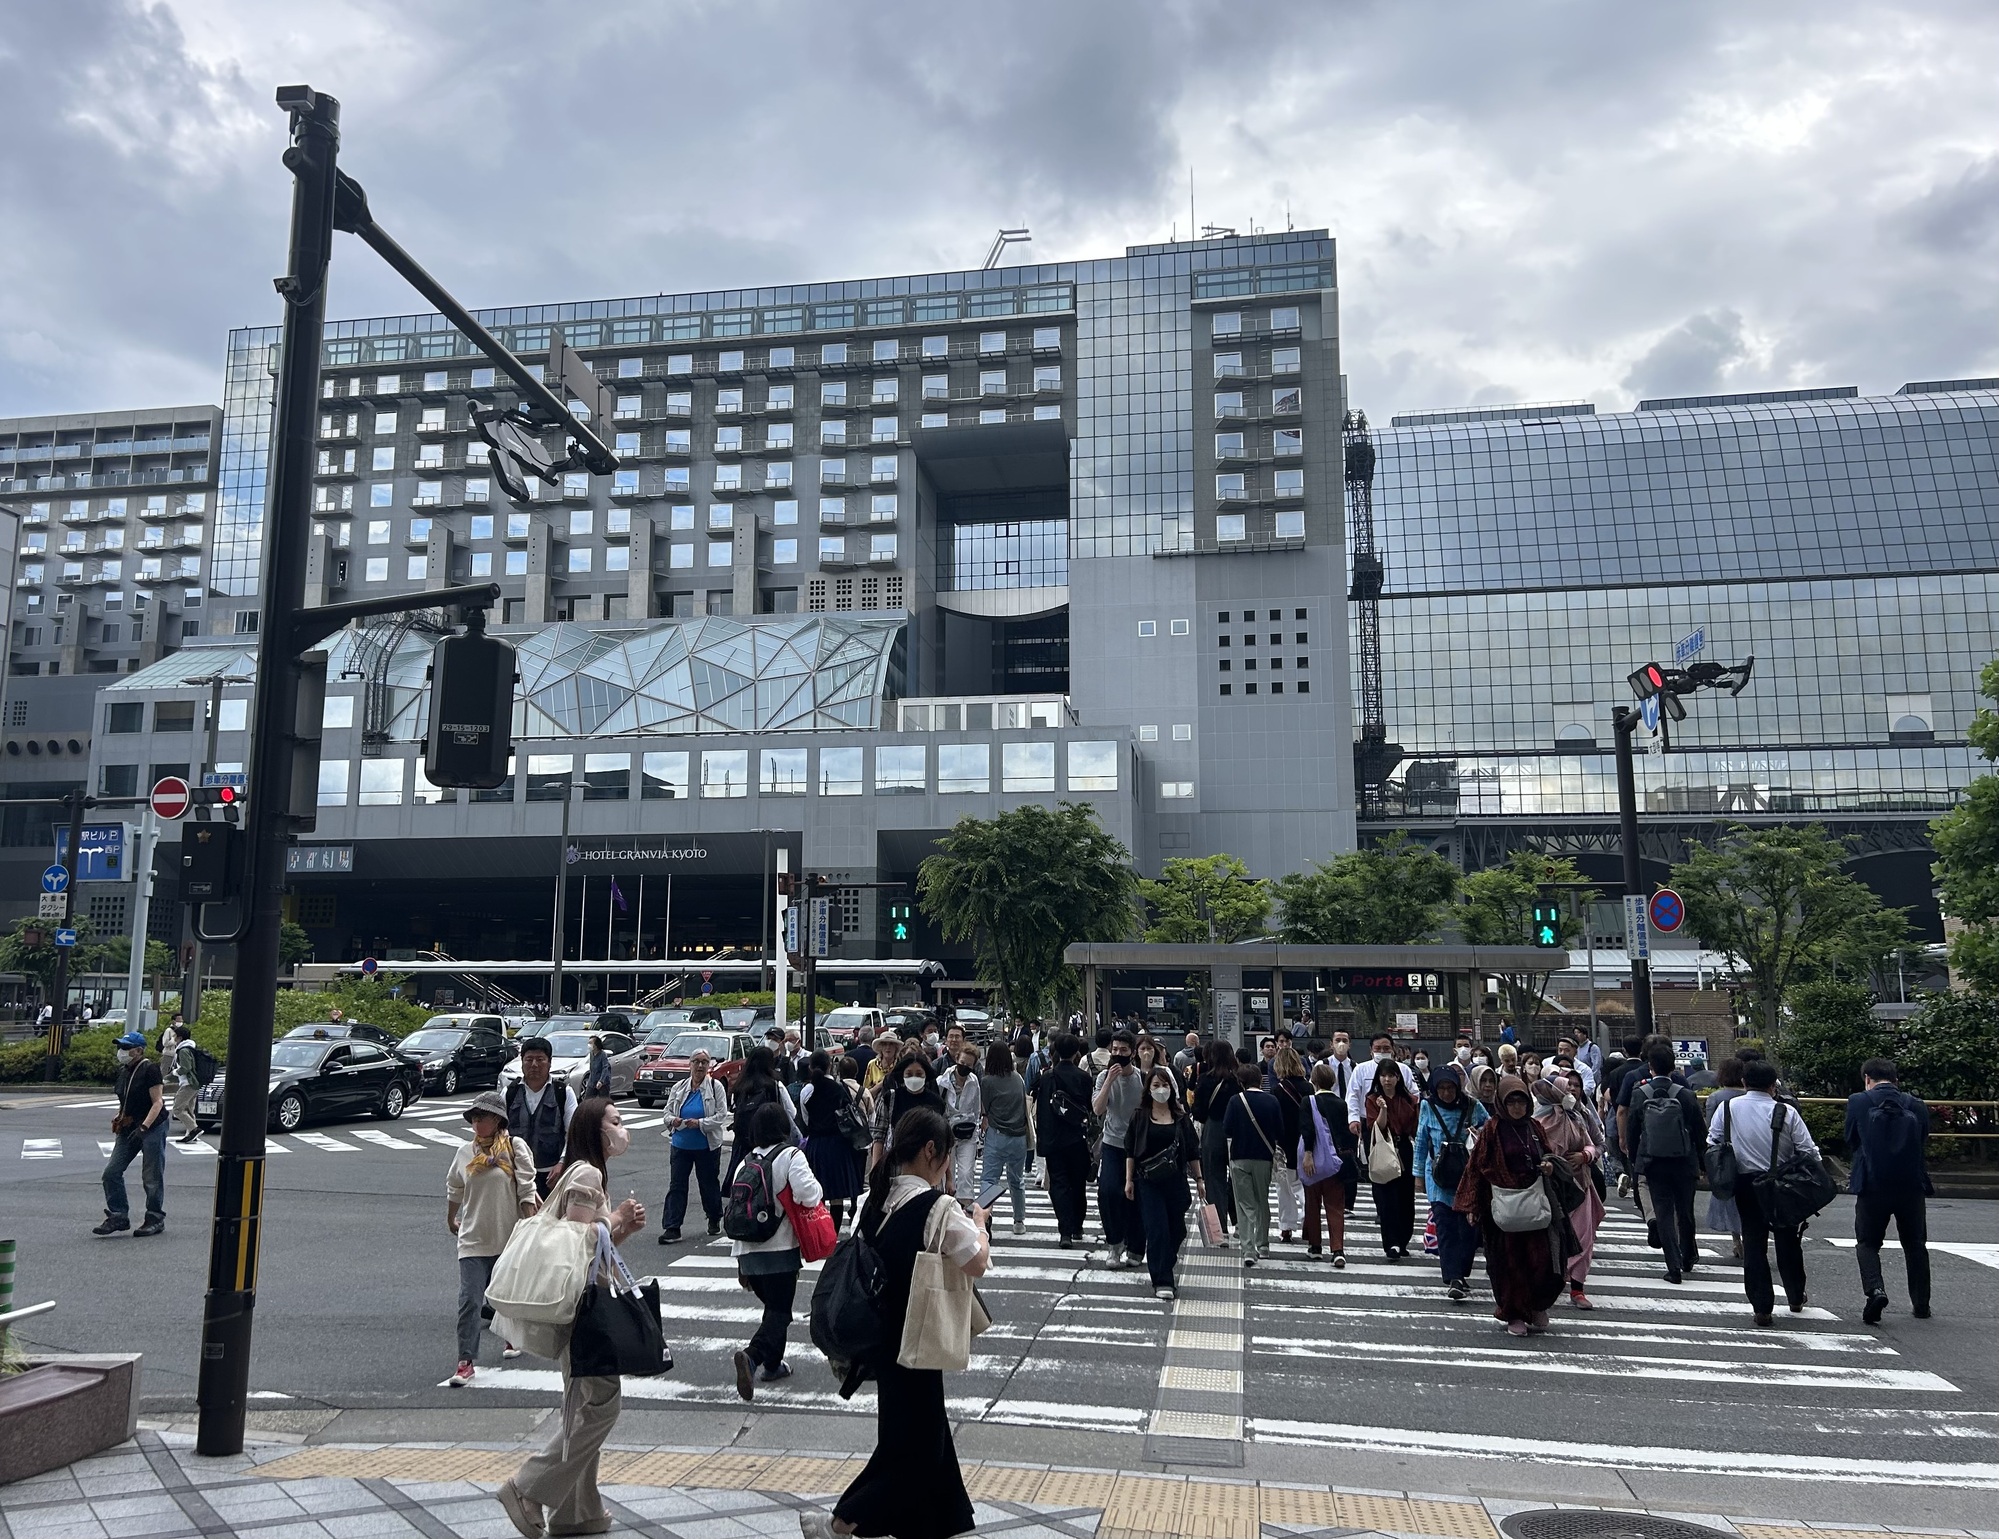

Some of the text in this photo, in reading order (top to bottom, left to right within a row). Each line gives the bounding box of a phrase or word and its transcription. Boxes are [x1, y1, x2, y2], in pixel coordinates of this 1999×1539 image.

[289, 851, 350, 868] 京都劇場
[585, 849, 708, 861] HOTEL GRANVIA KYOTO
[41, 904, 65, 912] タクシー
[1635, 897, 1648, 957] 歩車分離信号機
[1351, 974, 1404, 988] Porta
